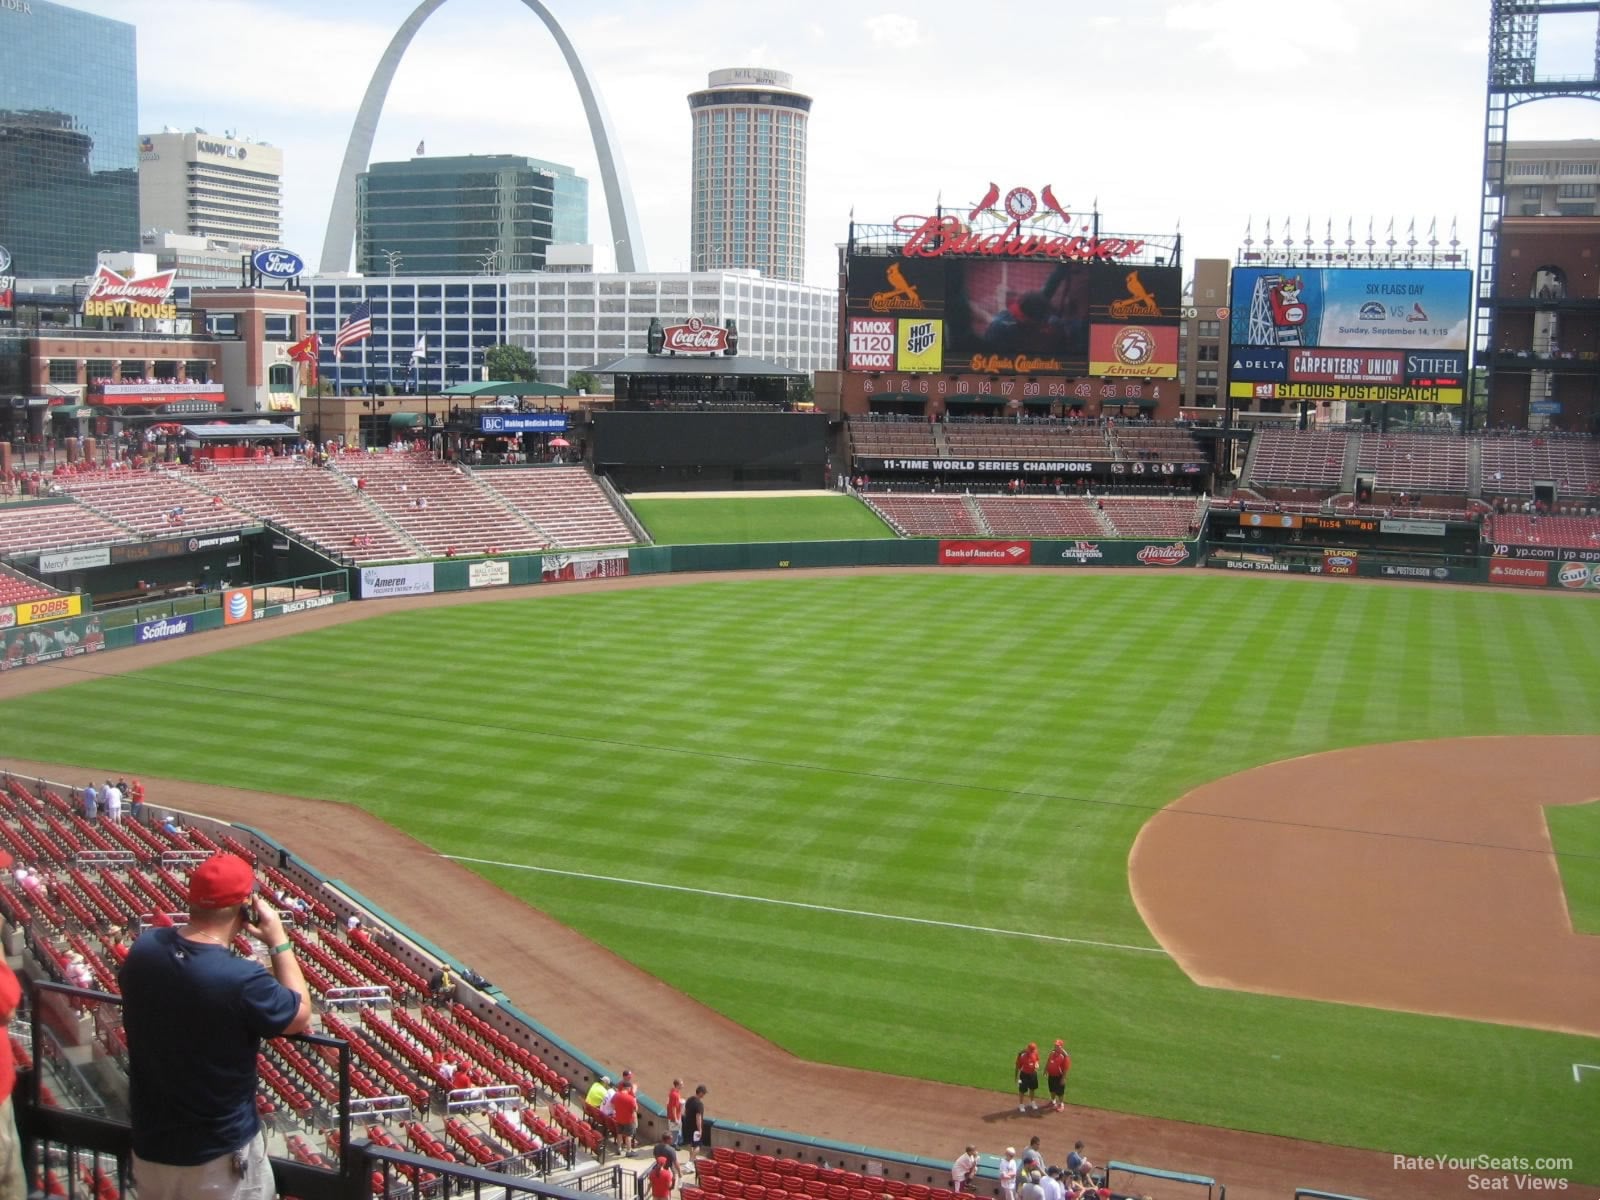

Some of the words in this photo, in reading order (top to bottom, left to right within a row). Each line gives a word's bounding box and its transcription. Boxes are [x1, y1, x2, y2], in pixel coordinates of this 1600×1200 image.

[197, 140, 225, 155] KMOV
[893, 214, 1145, 258] Budweiser
[265, 252, 296, 274] Ford
[1260, 251, 1326, 264] WORLD
[1332, 252, 1447, 265] CHAMPIONS
[90, 276, 175, 298] Budweiser
[1366, 284, 1379, 295] SIX
[1381, 284, 1406, 295] FLAGS
[1408, 284, 1425, 295] DAY
[85, 300, 127, 317] BREW
[130, 302, 177, 320] HOUSE
[1390, 305, 1404, 317] VS
[852, 321, 891, 334] KMOX
[910, 323, 932, 338] HOT
[1339, 326, 1370, 335] Sunday,
[1372, 327, 1415, 336] September
[1432, 328, 1448, 336] 1:15
[853, 336, 891, 351] 1120
[907, 333, 935, 353] SHOT
[852, 354, 890, 367] KMOX
[1246, 360, 1285, 369] DELTA
[1294, 356, 1363, 374] CARPENTERS'
[1367, 359, 1399, 375] UNION
[1407, 356, 1462, 374] STIFEL
[901, 380, 910, 393] 2
[919, 381, 929, 394] 6
[937, 381, 947, 394] 9
[956, 381, 969, 394] 10
[978, 381, 992, 395] 14
[1001, 382, 1014, 396] 17
[1023, 383, 1040, 396] 20
[1049, 383, 1065, 396] 24
[1074, 384, 1092, 397] 42
[1100, 384, 1117, 398] 45
[1125, 385, 1142, 398] 85
[1278, 384, 1296, 397] ST.
[1298, 384, 1335, 398] LOUIS
[1340, 385, 1439, 401] POST-DISPATCH
[485, 418, 502, 429] BJC
[883, 460, 929, 470] 11-TIME
[933, 460, 975, 470] WORLD
[978, 461, 1020, 471] SERIES
[1023, 462, 1092, 472] CHAMPIONS
[1320, 519, 1340, 528] 11:54
[945, 549, 965, 557] Bank
[965, 549, 973, 557] of
[974, 549, 1005, 557] America
[1493, 544, 1509, 555] yp
[1515, 548, 1554, 557] yp.com
[1563, 550, 1576, 559] yp
[1227, 560, 1253, 568] BUSCH
[1255, 561, 1289, 571] STADIUM
[1503, 567, 1524, 576] State
[1524, 569, 1545, 577] Farm
[1560, 567, 1589, 581] Gulf
[374, 577, 406, 588] Ameren
[31, 600, 69, 615] DOBBS
[282, 601, 304, 614] BUSCH
[306, 595, 334, 609] STADIUM
[142, 620, 187, 640] Scottrade
